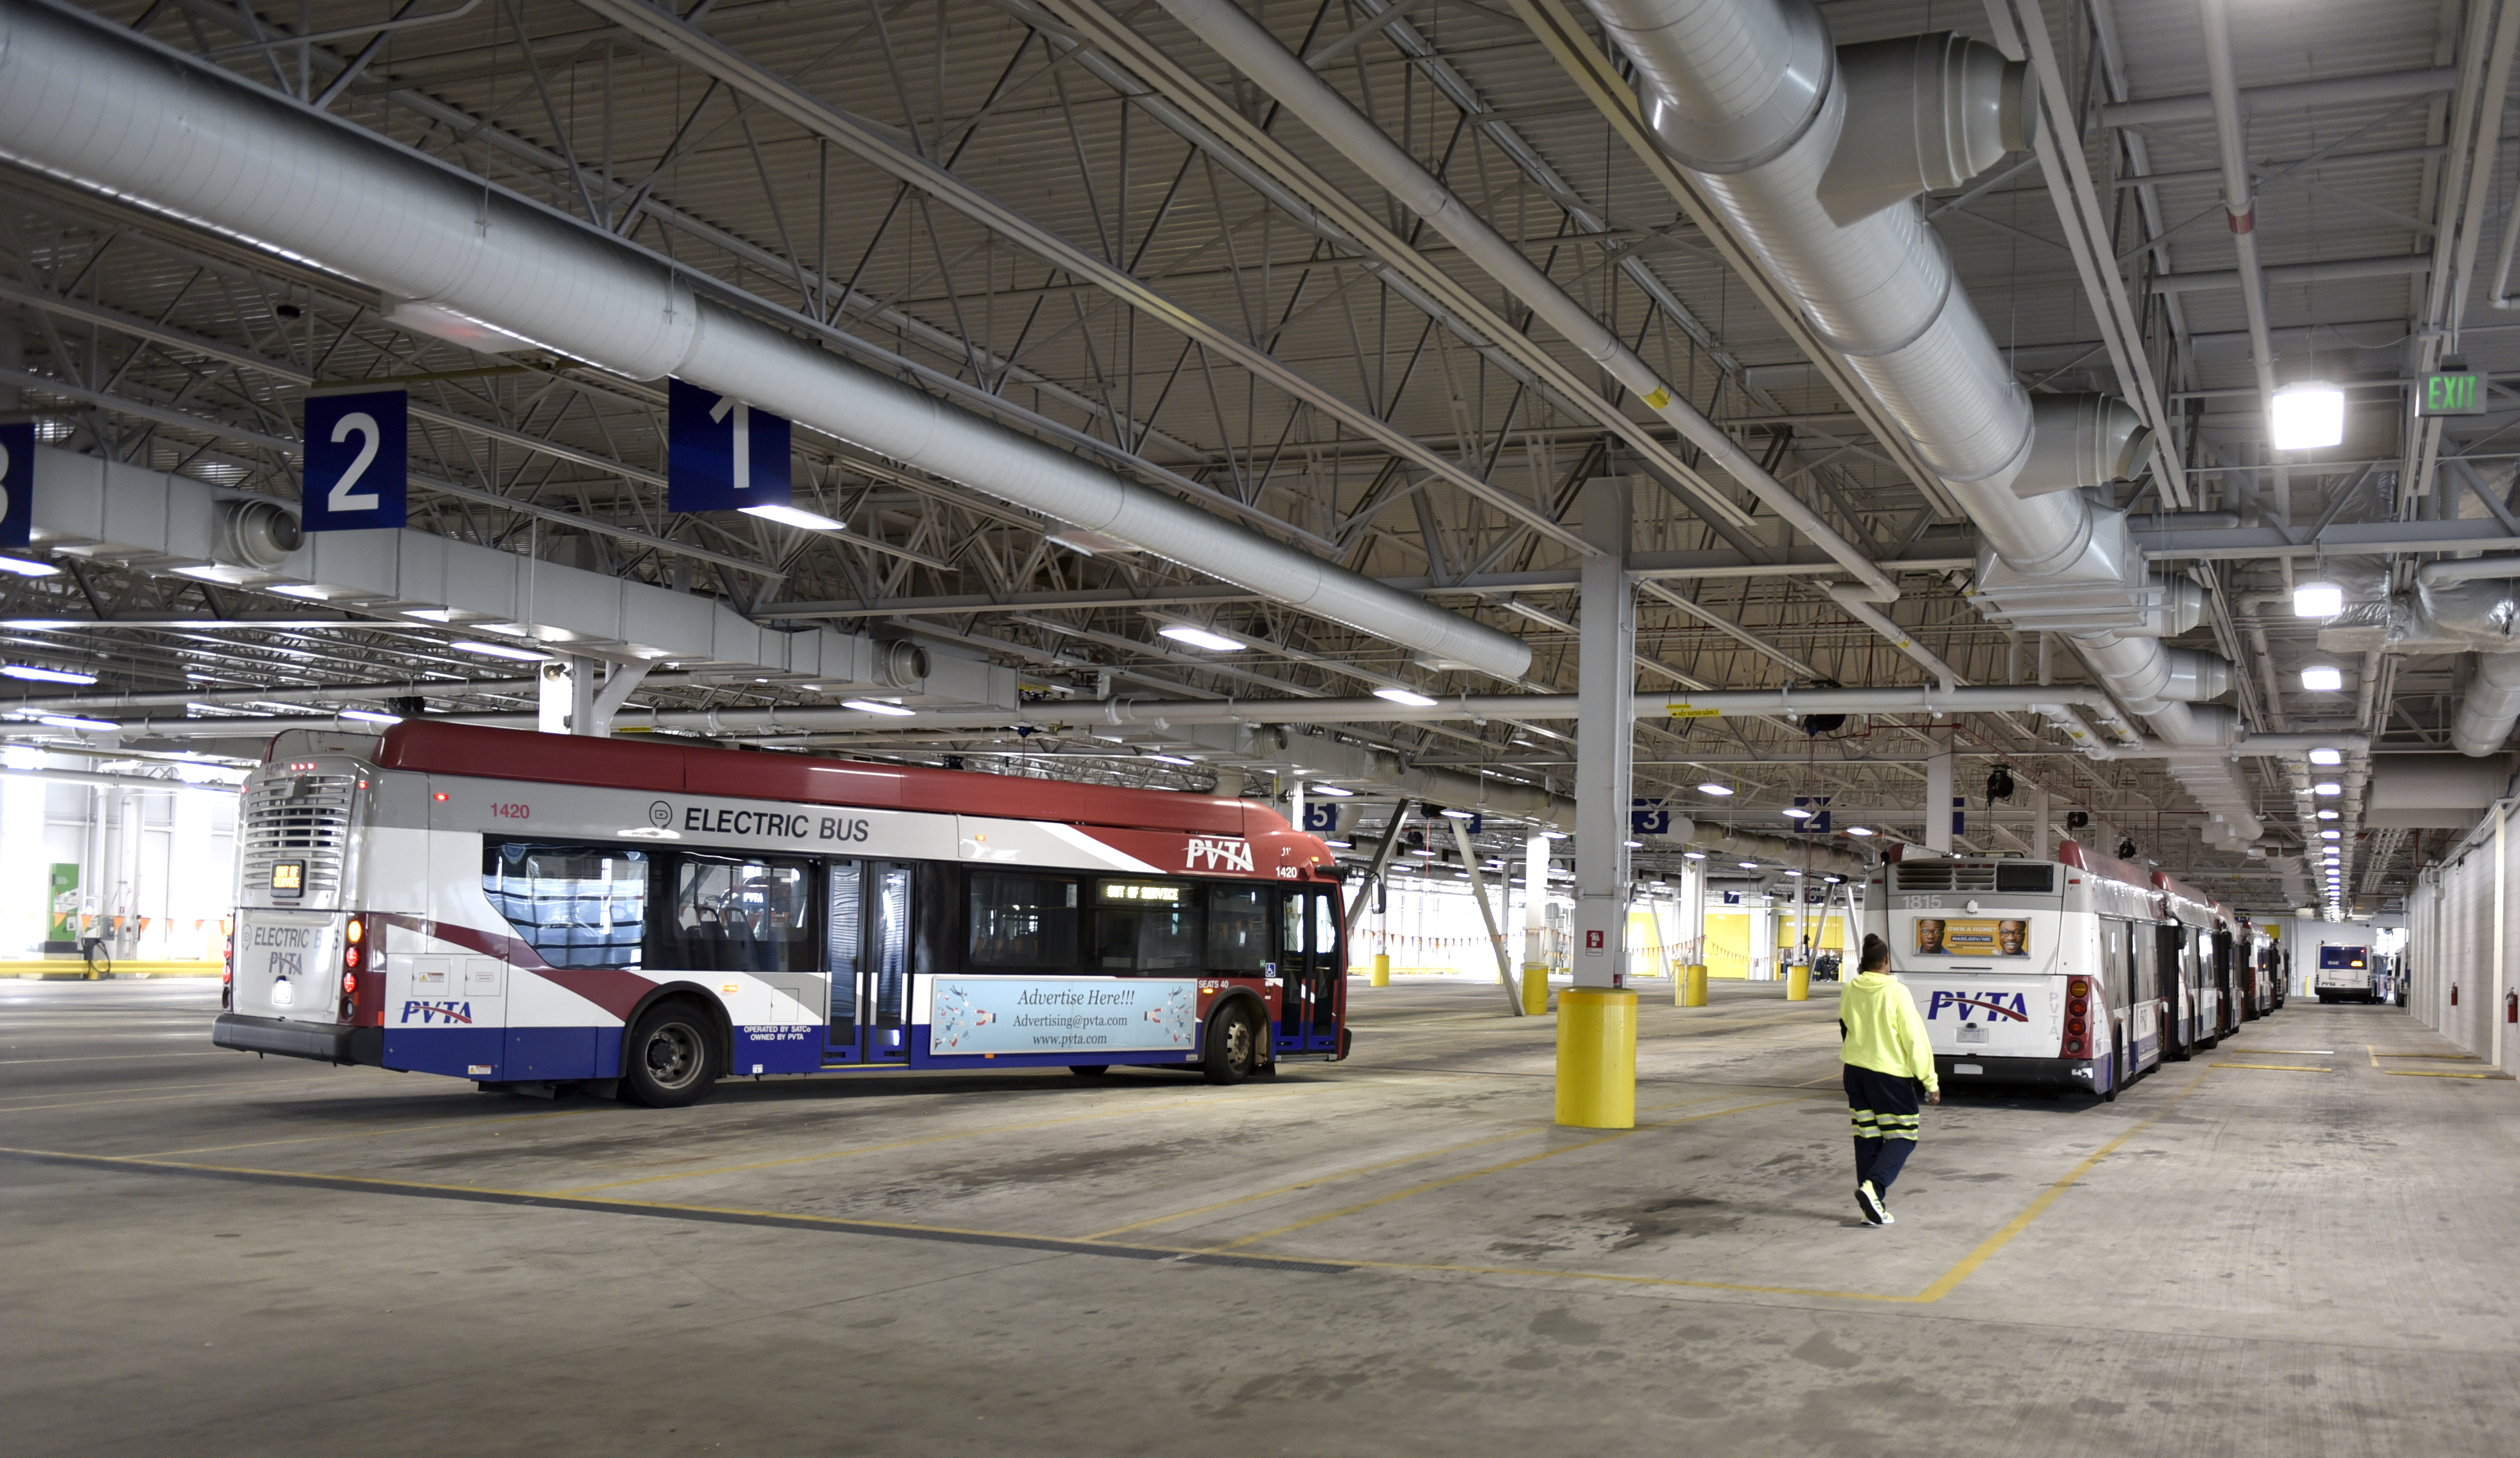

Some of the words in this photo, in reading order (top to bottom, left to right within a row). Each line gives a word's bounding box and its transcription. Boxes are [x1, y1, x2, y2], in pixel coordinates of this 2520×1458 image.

[2428, 377, 2477, 409] EXIT
[709, 395, 750, 489] 1
[328, 412, 380, 512] 2
[490, 803, 530, 819] 1420
[1312, 803, 1328, 827] 5
[1642, 803, 1660, 829] 3
[1803, 802, 1821, 829] 2
[684, 807, 809, 839] ELECTRIC
[819, 817, 870, 842] BUS
[1186, 839, 1255, 871] PVTA
[274, 877, 300, 888] SERVICE
[276, 865, 289, 877] OUT
[290, 865, 299, 877] OF
[1275, 866, 1297, 878] 1420
[1141, 887, 1179, 900] SERVICE
[1902, 895, 1942, 909] 1815
[254, 927, 310, 948] ELECTRIC
[268, 951, 303, 975] PVTA
[1198, 980, 1219, 988] SEATS
[1220, 980, 1229, 988] 40
[1016, 988, 1084, 1005] Advertise
[1087, 990, 1135, 1005] Here!!!
[1927, 991, 2029, 1022] PVTA
[400, 1000, 472, 1024] PVTA
[1012, 1014, 1128, 1029] Advertising@pvta.com
[2049, 992, 2059, 1036] PVTA
[1033, 1034, 1107, 1047] www.pvta.com
